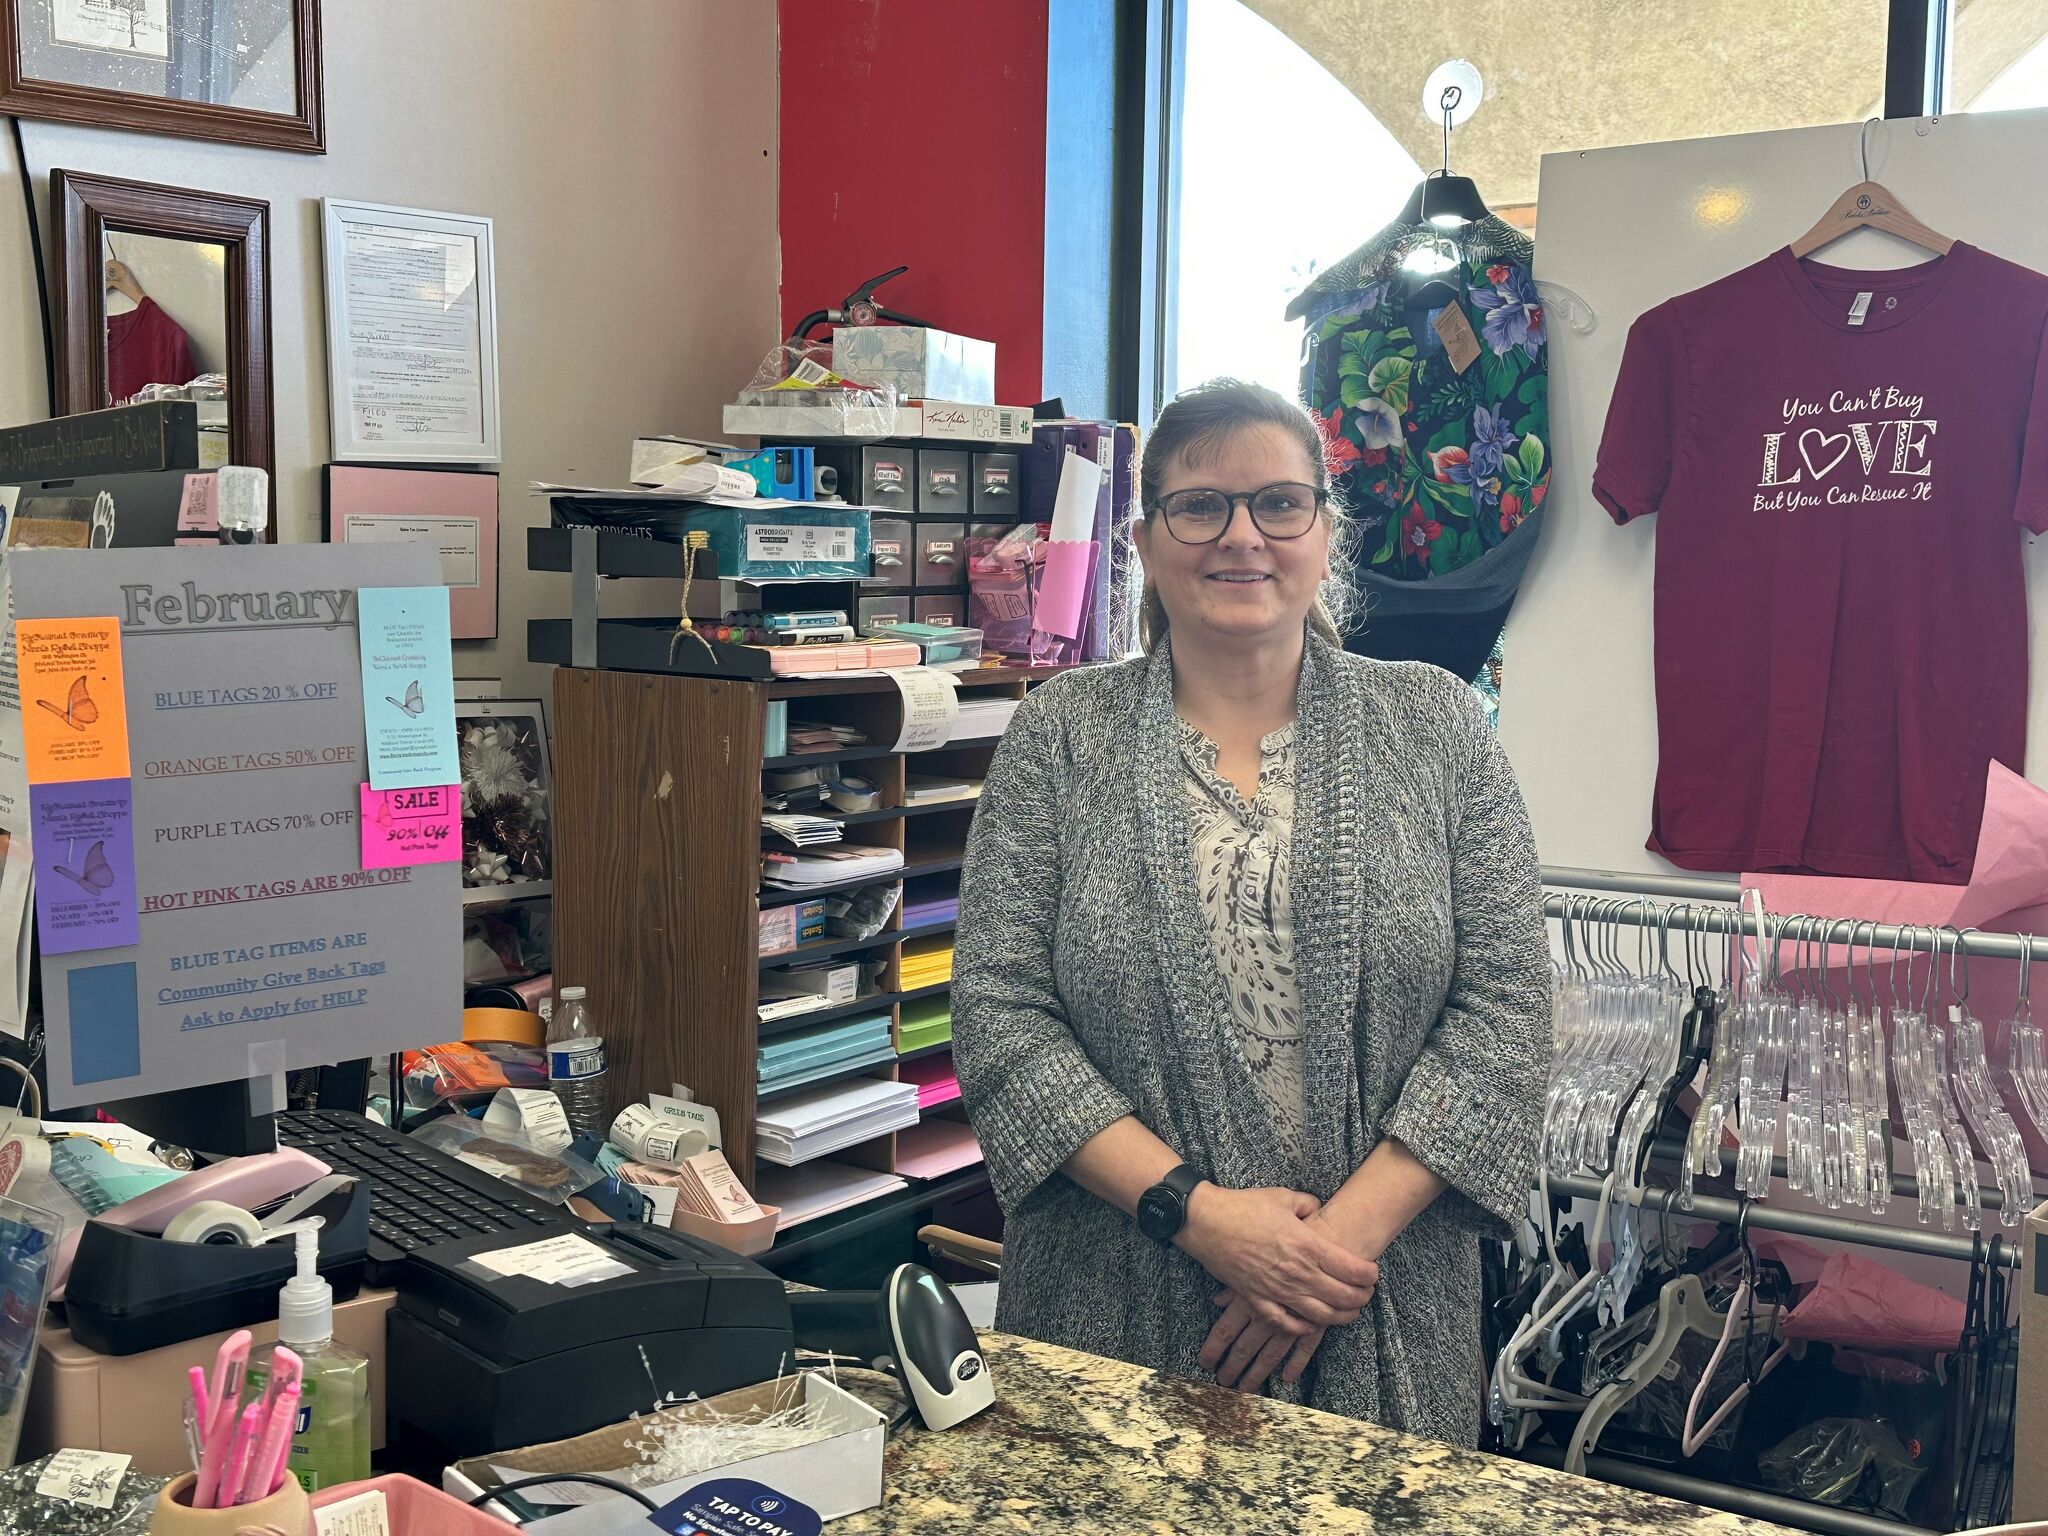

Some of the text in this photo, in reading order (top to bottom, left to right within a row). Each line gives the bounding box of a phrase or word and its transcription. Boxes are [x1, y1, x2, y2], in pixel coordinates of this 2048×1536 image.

[1783, 386, 1924, 424] You Can't Buy
[1753, 482, 1932, 512] But You Can Rescue It
[120, 581, 354, 630] February
[155, 682, 337, 708] BLUE TAGS 20 % OFF
[144, 746, 355, 777] ORANGE TAGS 50% OFF
[394, 791, 439, 810] SALE
[155, 810, 354, 843] PURPLE TAGS 70% OFF
[386, 824, 450, 841] 90% Off
[144, 866, 412, 911] HOT PINK TAGS ARE 90% OFF
[801, 926, 823, 937] Scotch
[170, 932, 368, 972] BLUE TAG ITEMS ARE
[158, 957, 386, 1004] Community Give Back Tags
[180, 987, 368, 1030] Ask to Apply for HELP
[682, 1511, 697, 1522] No
[708, 1496, 794, 1536] TAP TO PAY
